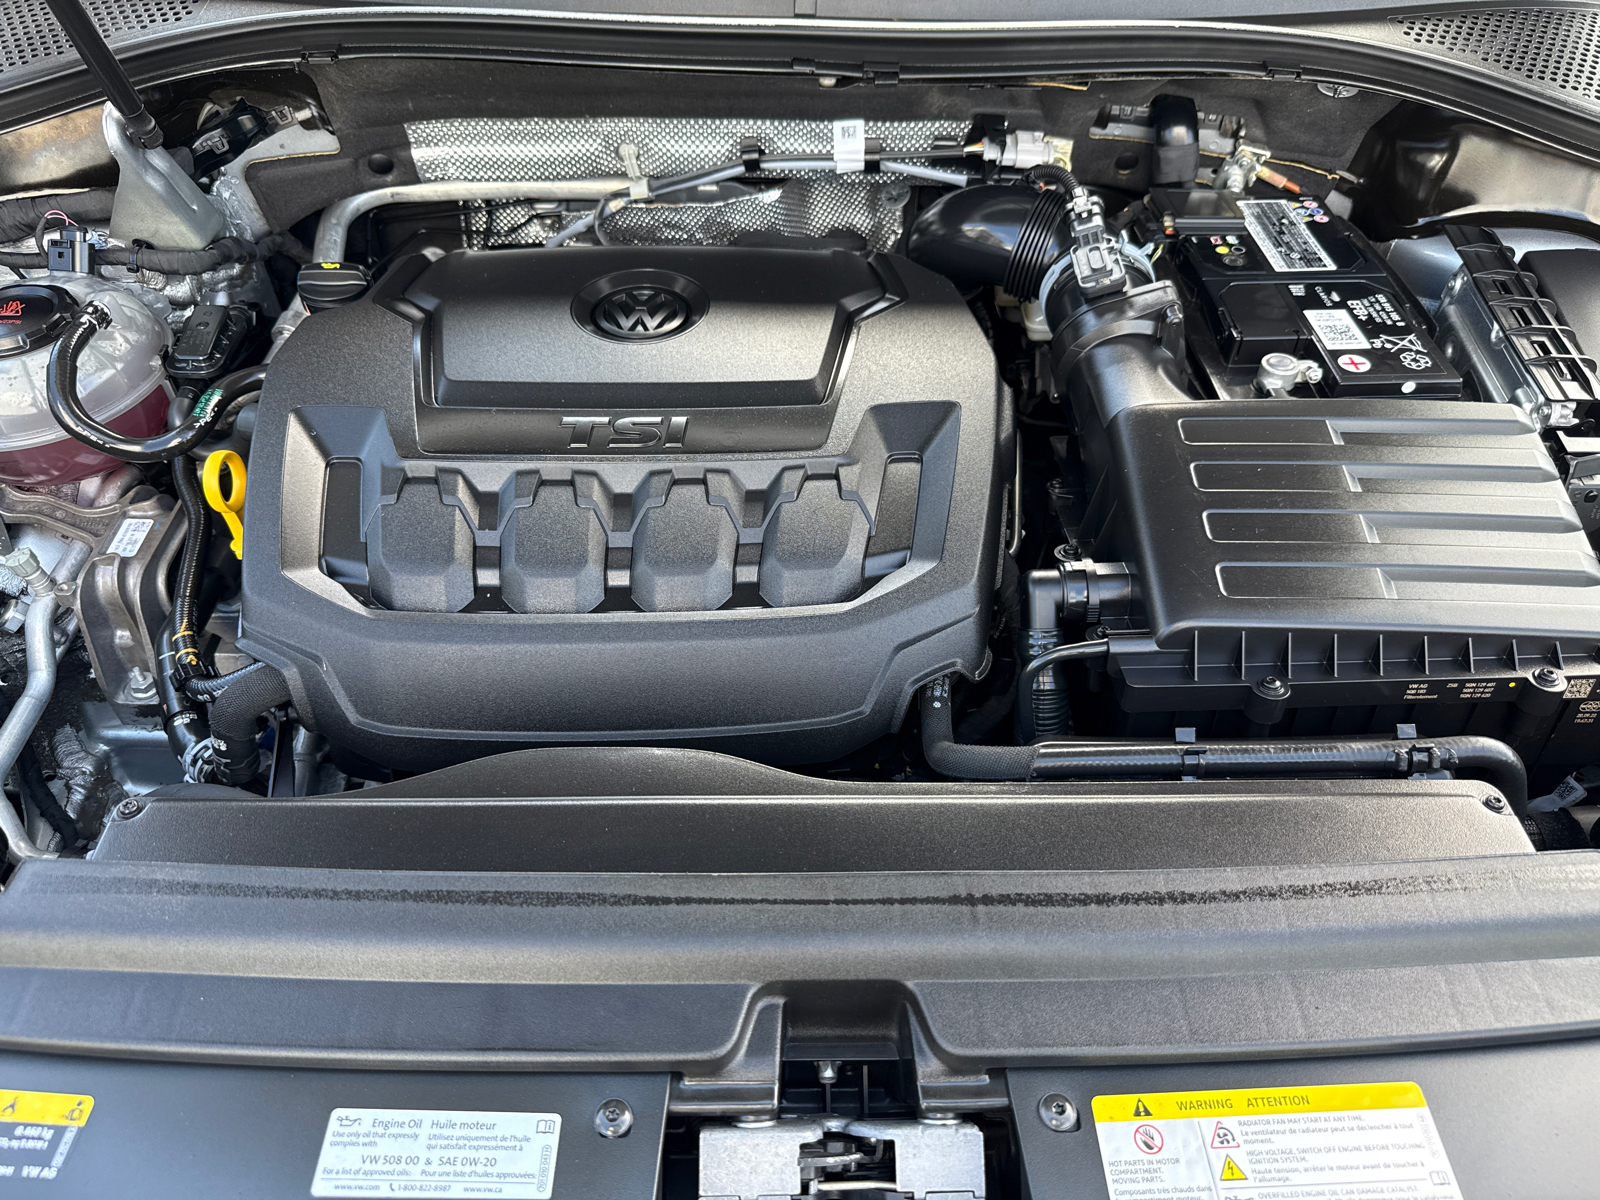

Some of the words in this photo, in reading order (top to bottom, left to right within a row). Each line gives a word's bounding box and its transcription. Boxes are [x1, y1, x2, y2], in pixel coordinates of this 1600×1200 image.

[1346, 300, 1368, 321] EFB+
[559, 416, 690, 448] TSI
[1176, 1098, 1234, 1111] WARNING
[1246, 1095, 1310, 1108] ATTENTION
[372, 1118, 406, 1130] Engine
[408, 1119, 423, 1129] Oil
[431, 1119, 457, 1129] Huile
[459, 1120, 497, 1130] moteur
[1238, 1119, 1271, 1127] RADIATOR
[1303, 1116, 1322, 1124] START
[1323, 1115, 1331, 1123] AT
[332, 1130, 345, 1138] Use
[346, 1131, 362, 1139] only
[362, 1130, 371, 1138] oil
[387, 1131, 420, 1140] expressly
[1240, 1129, 1249, 1137] Le
[1250, 1127, 1287, 1136] ventilateur
[1298, 1126, 1329, 1134] radiateur
[1330, 1124, 1345, 1134] peut
[1356, 1123, 1392, 1131] déclencher
[428, 1132, 454, 1140] Utilisez
[455, 1133, 498, 1143] uniquement
[510, 1134, 531, 1142] l'huile
[330, 1139, 360, 1148] complies
[426, 1142, 438, 1150] qui
[439, 1142, 467, 1150] satisfait
[468, 1143, 517, 1152] expressément
[1246, 1149, 1264, 1157] HIGH
[1296, 1147, 1322, 1155] SWITCH
[1324, 1145, 1337, 1153] OFF
[1338, 1144, 1363, 1152] ENGINE
[1364, 1143, 1390, 1151] BEFORE
[1390, 1142, 1426, 1150] TOUCHING
[361, 1154, 381, 1165] VW
[382, 1155, 403, 1165] 508
[404, 1155, 420, 1165] 00
[424, 1157, 433, 1166] &
[438, 1156, 459, 1166] SAE
[461, 1157, 497, 1167] 0W-20
[1124, 1159, 1146, 1167] PARTS
[1146, 1158, 1154, 1166] IN
[1155, 1157, 1181, 1165] MOTOR
[1248, 1157, 1280, 1165] IGNITION
[322, 1167, 334, 1175] For
[341, 1167, 352, 1175] list
[353, 1167, 362, 1175] of
[362, 1168, 396, 1177] approved
[396, 1168, 412, 1176] oils:
[1110, 1167, 1164, 1176] COMPARTMENT.
[1251, 1167, 1272, 1175] Haute
[1274, 1166, 1302, 1174] tension,
[1303, 1164, 1326, 1172] arrêter
[1336, 1163, 1360, 1171] moteur
[1383, 1161, 1391, 1169] de
[1393, 1160, 1418, 1168] toucher
[421, 1169, 437, 1177] Pour
[453, 1169, 467, 1177] liste
[468, 1169, 494, 1178] d'huiles
[495, 1171, 537, 1180] approuvées:
[1111, 1176, 1140, 1185] MOVING
[1141, 1175, 1166, 1184] PARTS.
[398, 1183, 451, 1192] 1-800-822-8987
[1114, 1187, 1156, 1197] Composants
[1157, 1186, 1170, 1194] très
[1171, 1185, 1195, 1193] chauds
[1258, 1190, 1300, 1199] OVERFILLED
[1301, 1189, 1326, 1198] ENGINE
[1327, 1188, 1339, 1196] OIL
[1356, 1186, 1384, 1195] DAMAGE
[1386, 1185, 1420, 1193] CATALYST.
